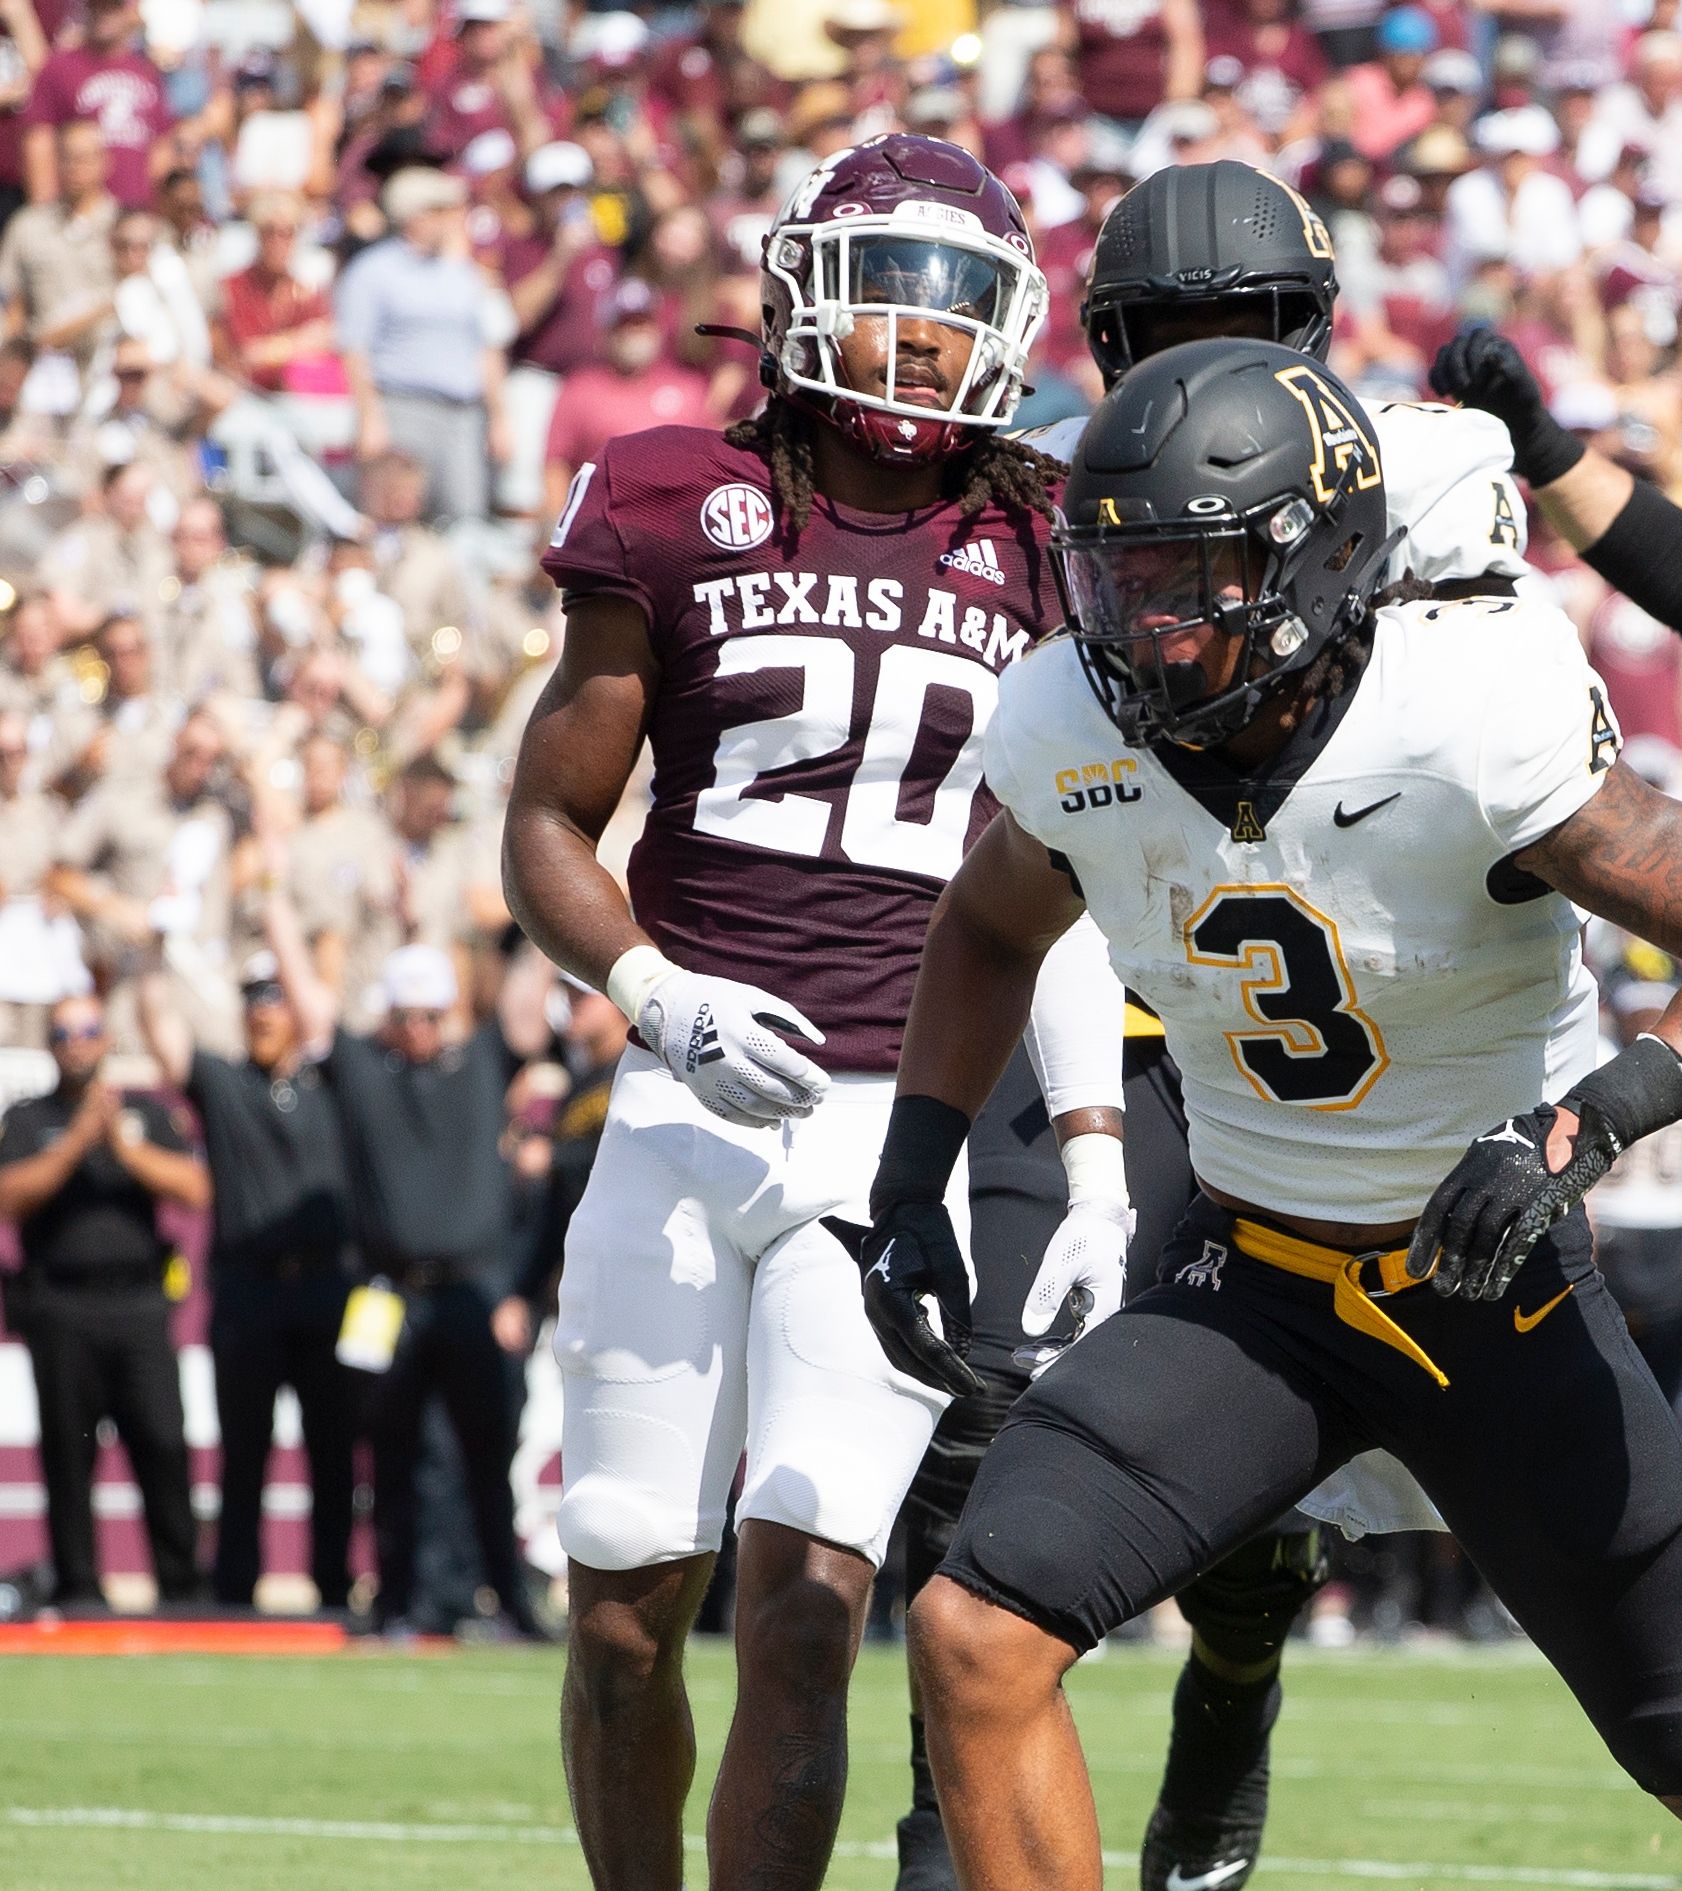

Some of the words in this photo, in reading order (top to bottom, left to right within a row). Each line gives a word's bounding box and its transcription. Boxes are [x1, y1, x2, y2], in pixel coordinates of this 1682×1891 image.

[1179, 268, 1212, 282] VICIS
[706, 489, 770, 547] SEC
[1490, 481, 1520, 550] A
[939, 552, 1006, 586] adidas
[693, 571, 904, 636] TEXAS
[917, 587, 1031, 667] A&M
[692, 633, 1000, 883] 20
[1055, 757, 1143, 814] SBC
[1233, 801, 1264, 840] A
[1183, 882, 1391, 1112] 3
[685, 1003, 710, 1074] adidas
